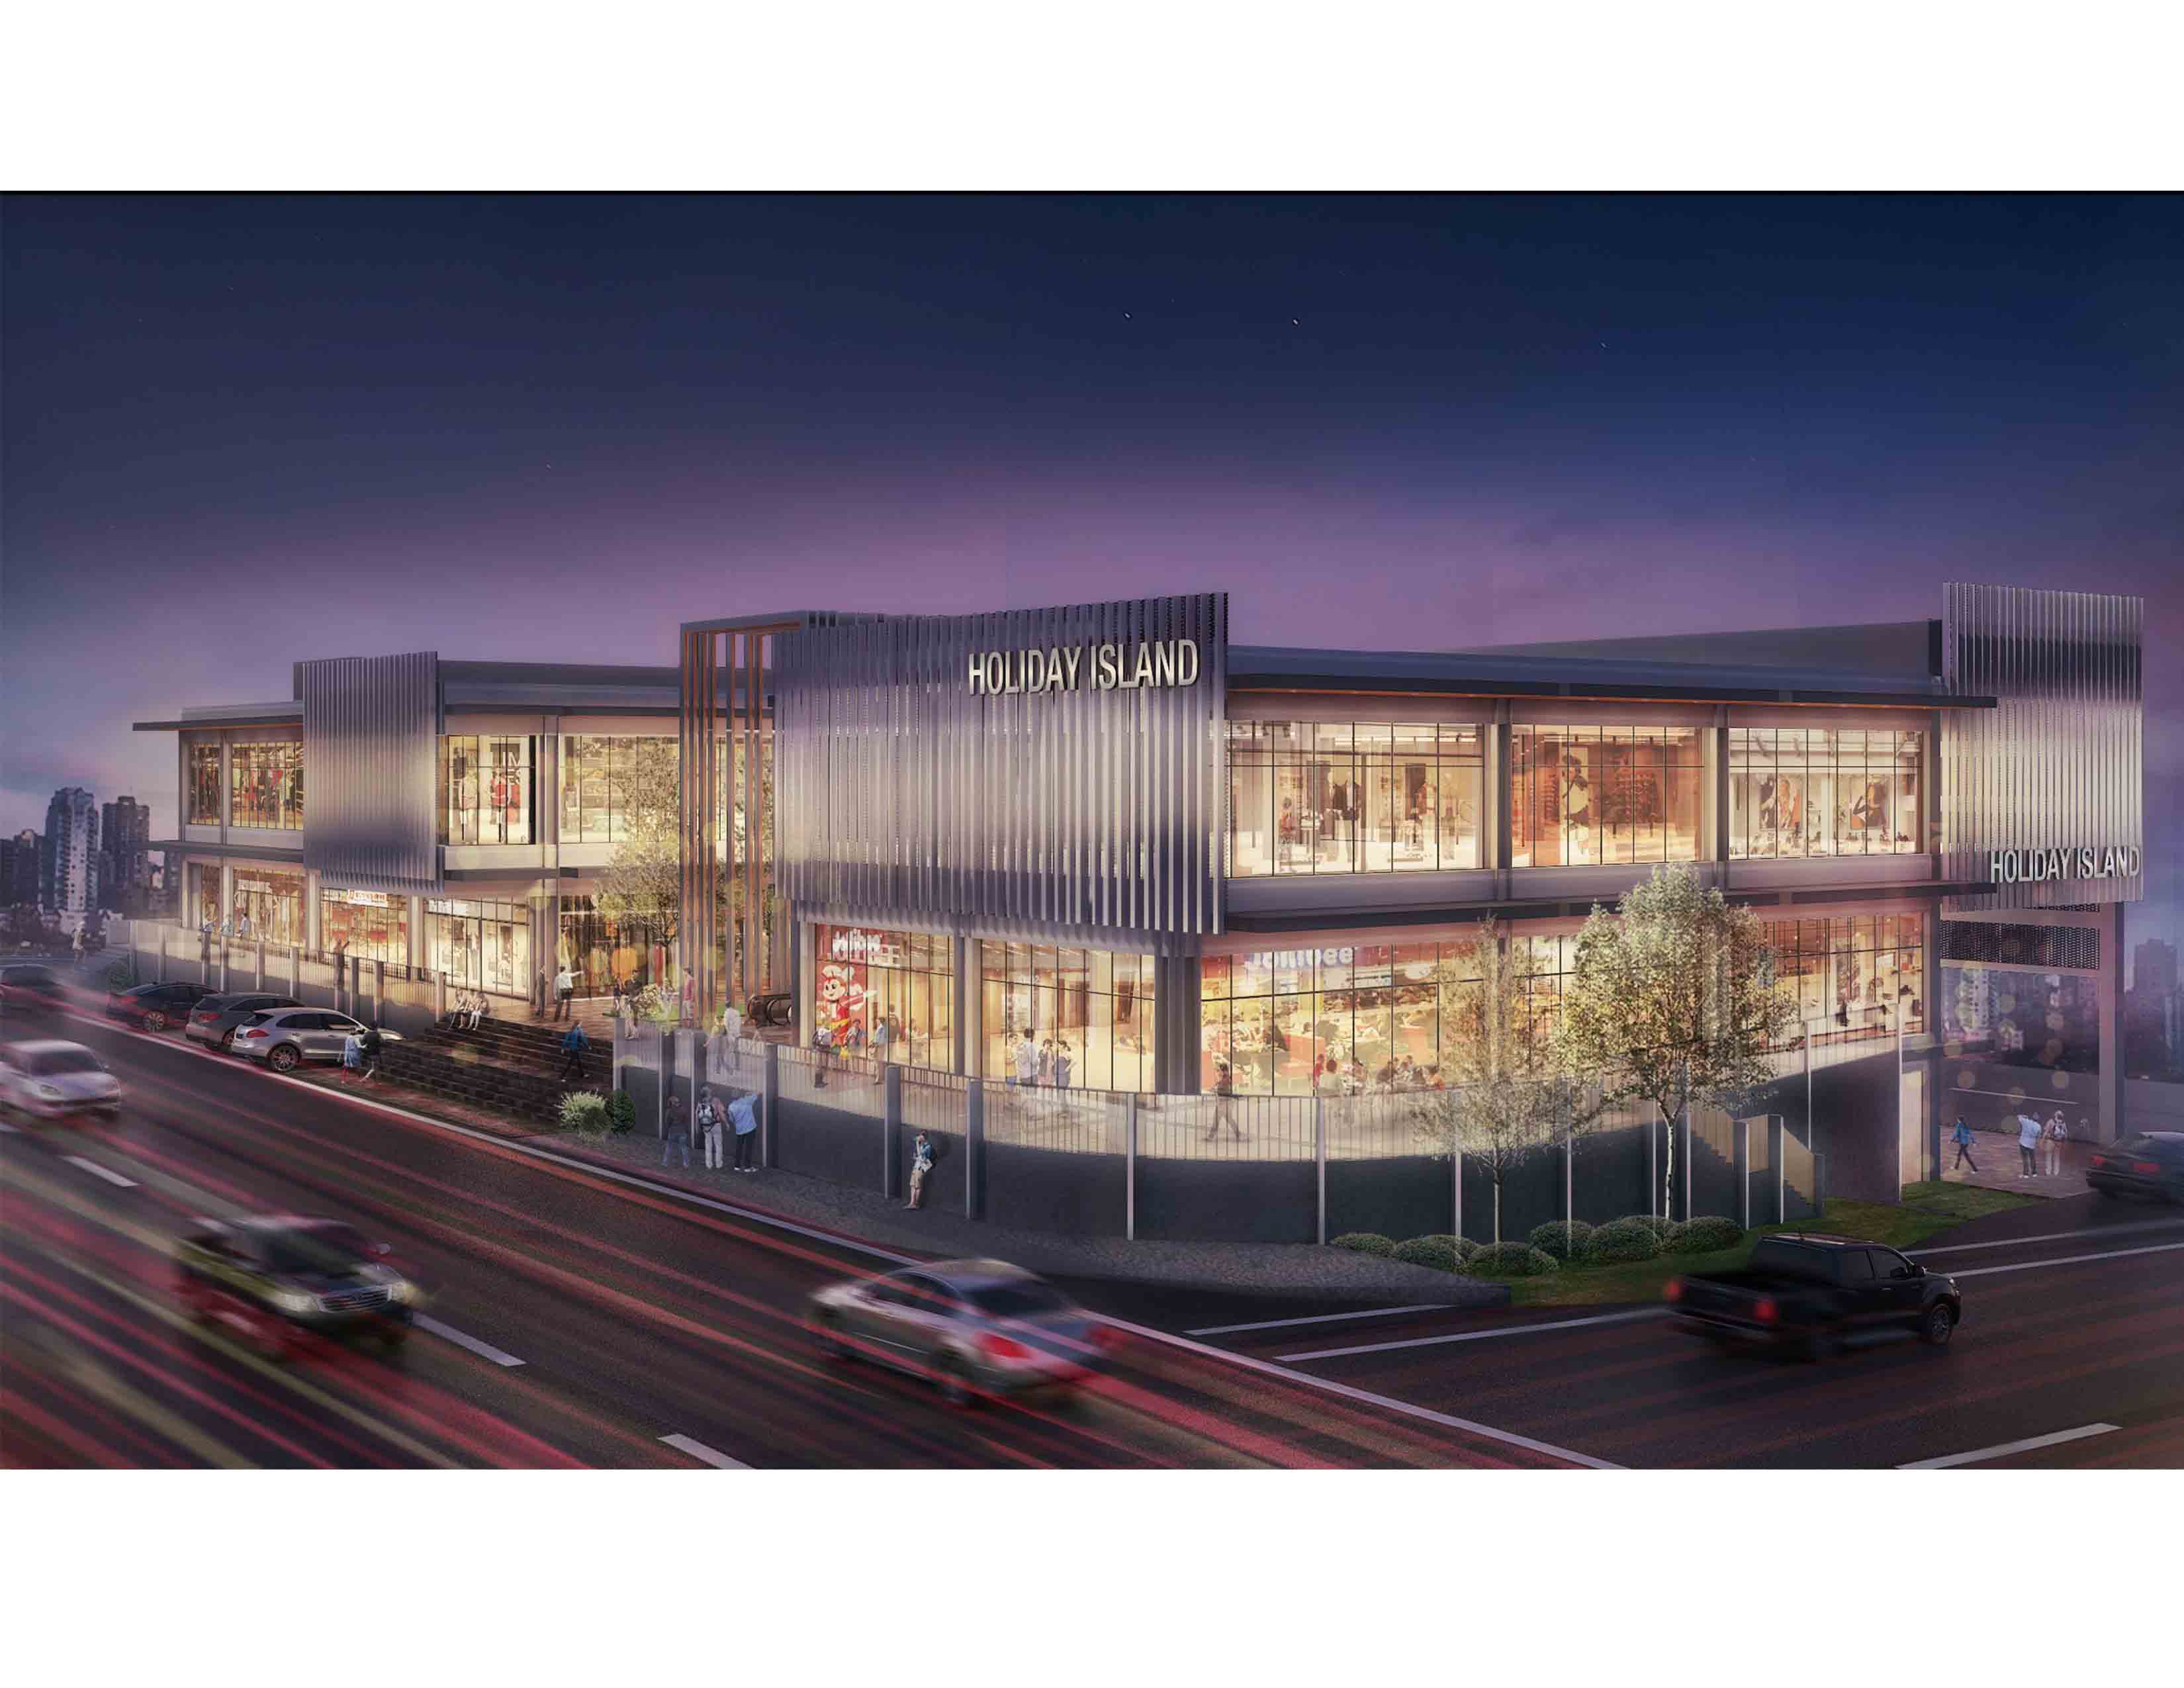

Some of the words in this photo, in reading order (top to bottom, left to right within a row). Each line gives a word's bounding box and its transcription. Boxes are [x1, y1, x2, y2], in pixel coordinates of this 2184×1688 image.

[968, 645, 1081, 695] HOLIDAY
[1090, 639, 1199, 690] ISLAND
[1990, 848, 2071, 884] HOLIDAY
[2077, 845, 2140, 879] ISLAND
